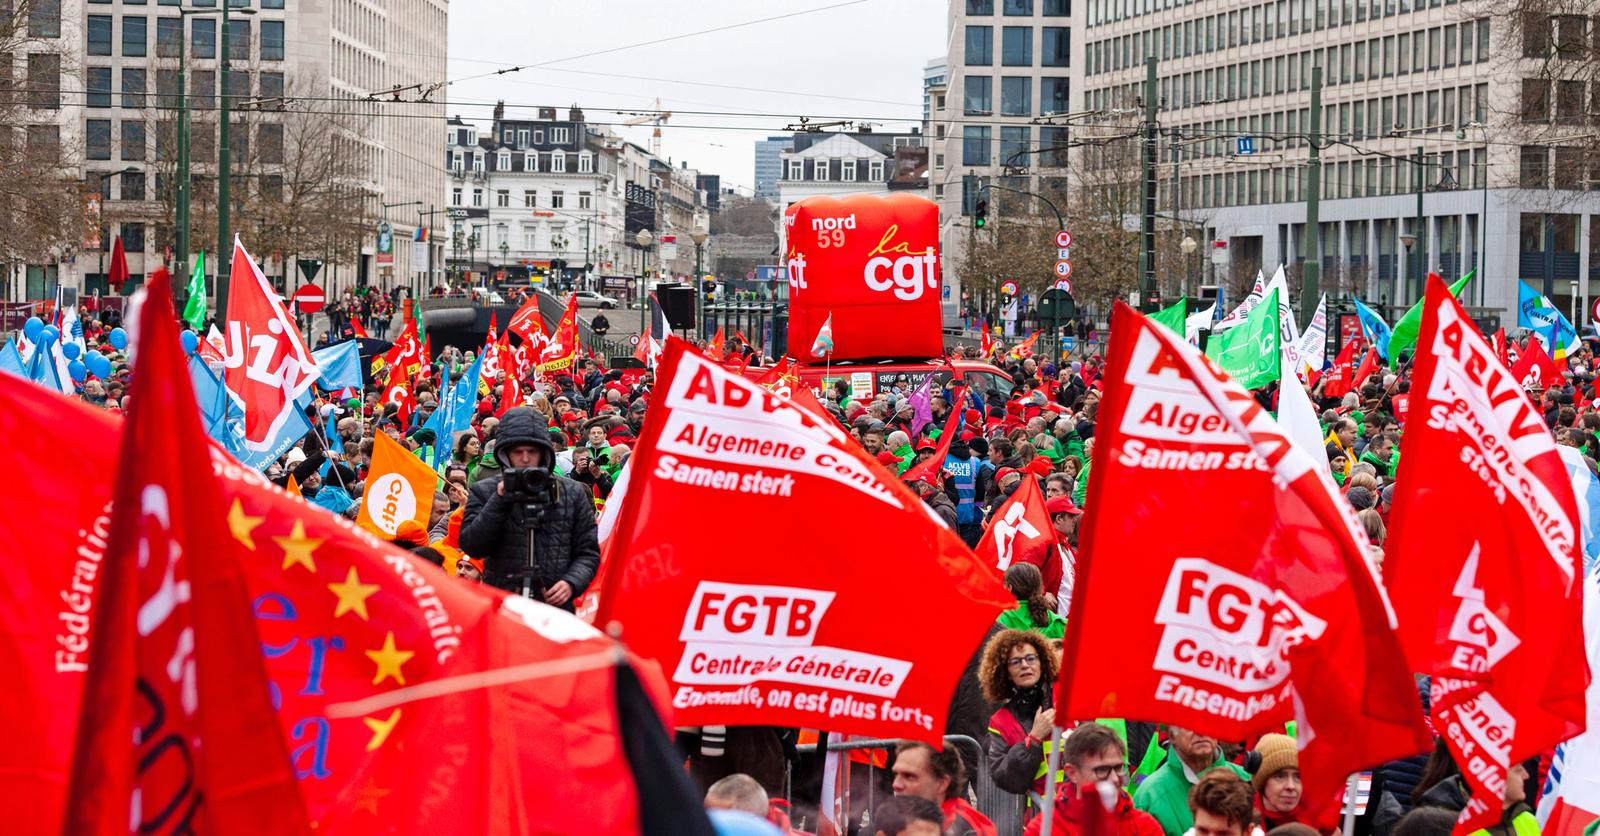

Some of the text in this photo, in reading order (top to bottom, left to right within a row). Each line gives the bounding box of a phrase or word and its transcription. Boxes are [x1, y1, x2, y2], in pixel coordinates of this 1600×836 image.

[812, 214, 856, 231] nord
[817, 230, 846, 248] 59
[868, 224, 936, 257] la
[864, 246, 938, 300] cgt
[674, 423, 806, 461] Algemene
[1119, 439, 1224, 471] Samen
[654, 454, 796, 497] Samen sterk
[948, 462, 971, 471] ACLVB
[694, 592, 816, 637] FGTB
[786, 655, 894, 687] Générale
[768, 687, 790, 708] on
[794, 690, 828, 713] est
[829, 694, 877, 721] plus
[881, 700, 934, 731] forts
